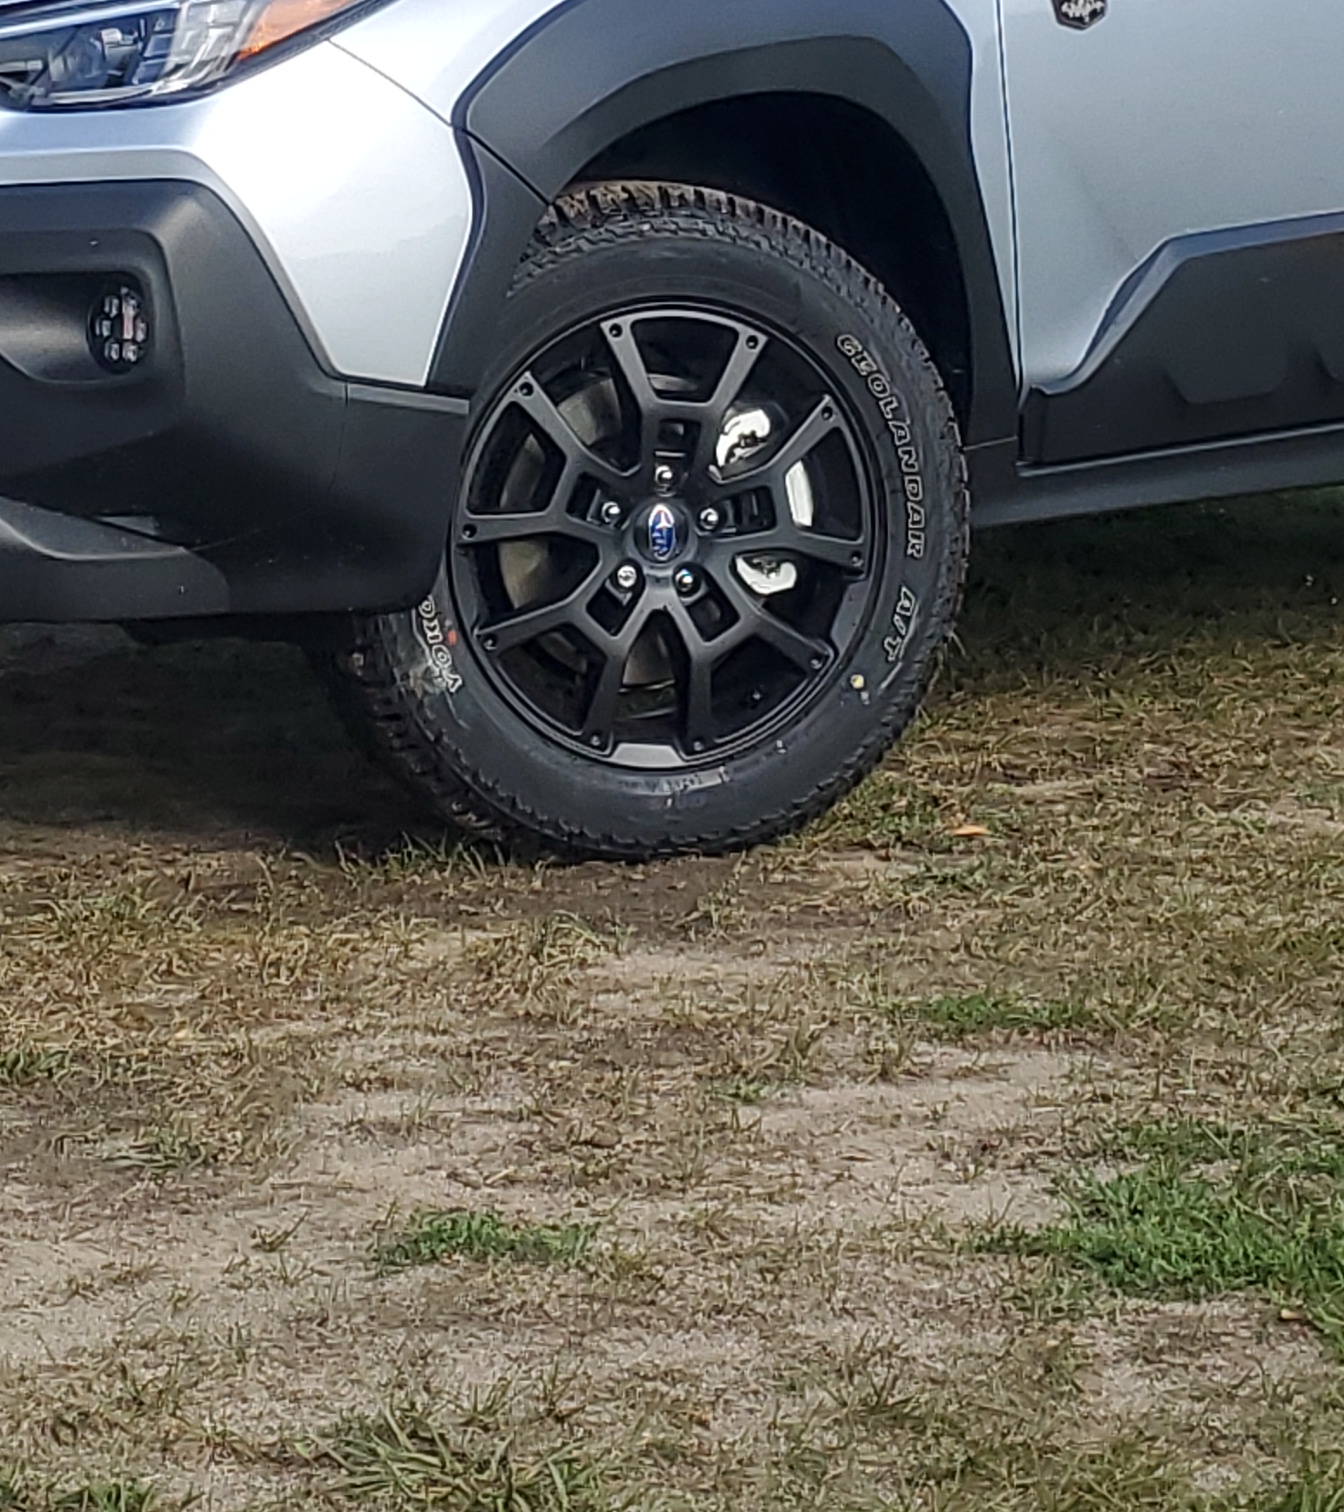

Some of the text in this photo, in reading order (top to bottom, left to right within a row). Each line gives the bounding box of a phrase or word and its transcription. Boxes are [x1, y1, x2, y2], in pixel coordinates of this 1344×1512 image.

[837, 333, 926, 662] GEOLANDAR A/T
[419, 594, 463, 693] YOKO
